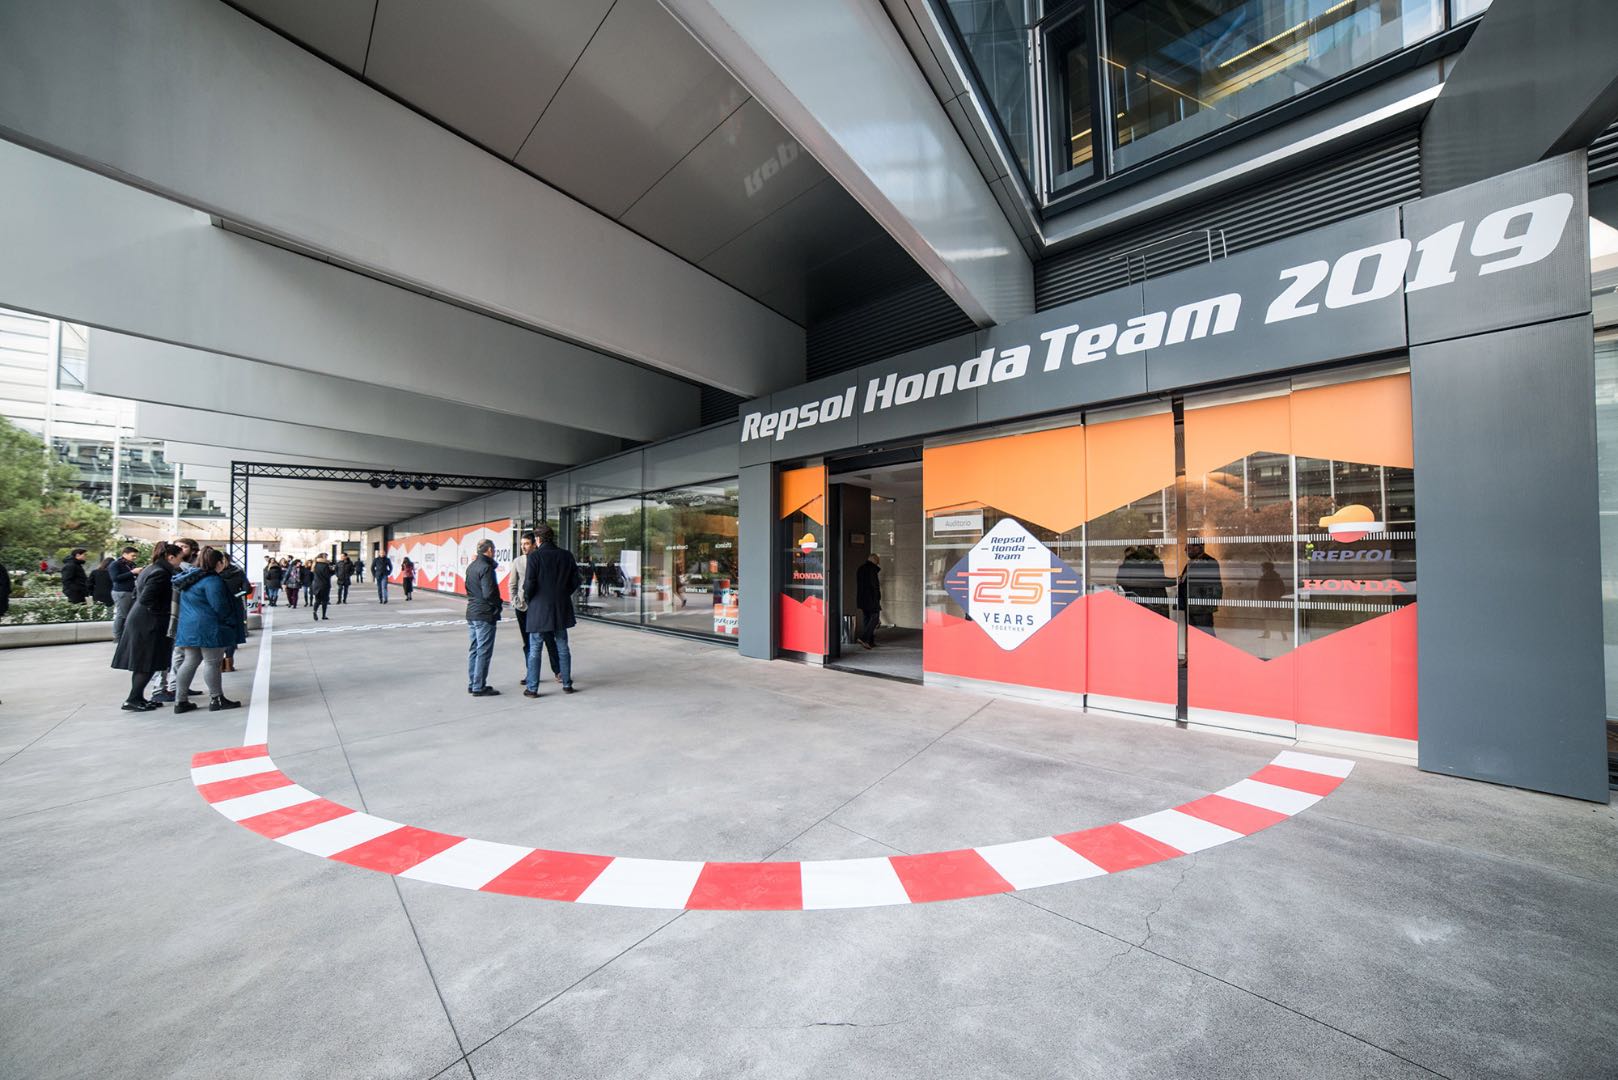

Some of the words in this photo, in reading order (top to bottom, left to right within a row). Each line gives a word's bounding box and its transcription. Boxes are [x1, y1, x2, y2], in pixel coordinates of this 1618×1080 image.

[740, 385, 856, 442] Repsol
[863, 343, 1031, 413] Honda
[1040, 292, 1242, 373] Team
[1264, 192, 1575, 325] 2019
[991, 536, 1025, 544] Repsol
[1312, 550, 1392, 561] REPSOL
[793, 572, 824, 580] HONDA
[970, 567, 1048, 605] 25
[1303, 579, 1406, 592] HONDA
[983, 613, 1034, 625] YEARS
[991, 624, 1025, 632] TOGETHER
